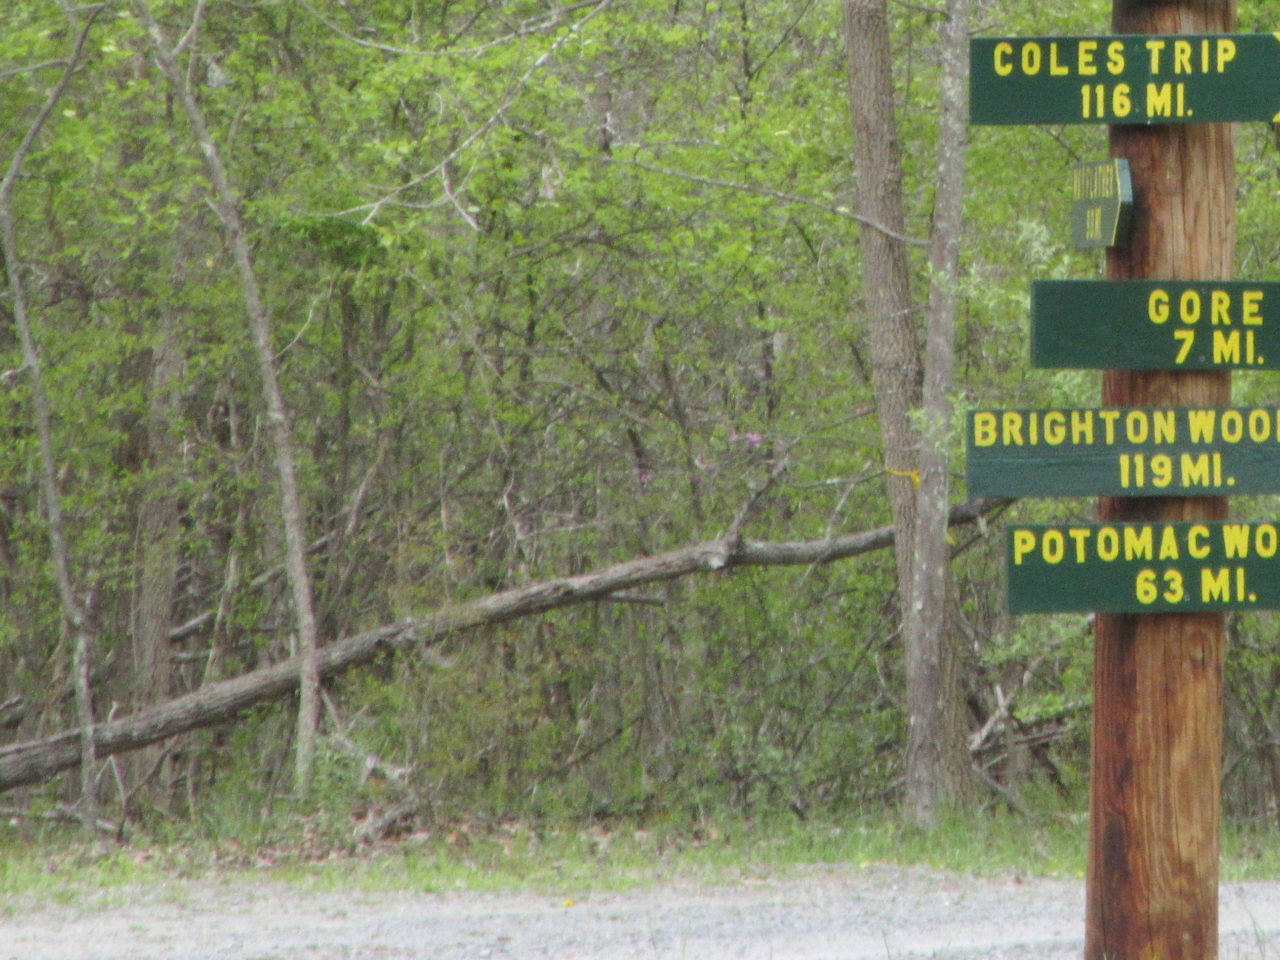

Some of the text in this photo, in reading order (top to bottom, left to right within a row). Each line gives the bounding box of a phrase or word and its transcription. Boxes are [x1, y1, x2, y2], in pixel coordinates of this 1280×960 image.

[994, 38, 1237, 76] COLES TRIP
[1081, 82, 1193, 118] 116 MI.
[1148, 289, 1264, 325] GORE
[1173, 329, 1265, 365] 7 MI.
[974, 409, 1176, 447] BRIGHTON
[1119, 451, 1236, 488] 119 MI.
[1013, 523, 1211, 565] POTOMAC
[1135, 567, 1257, 604] 63 MI.
